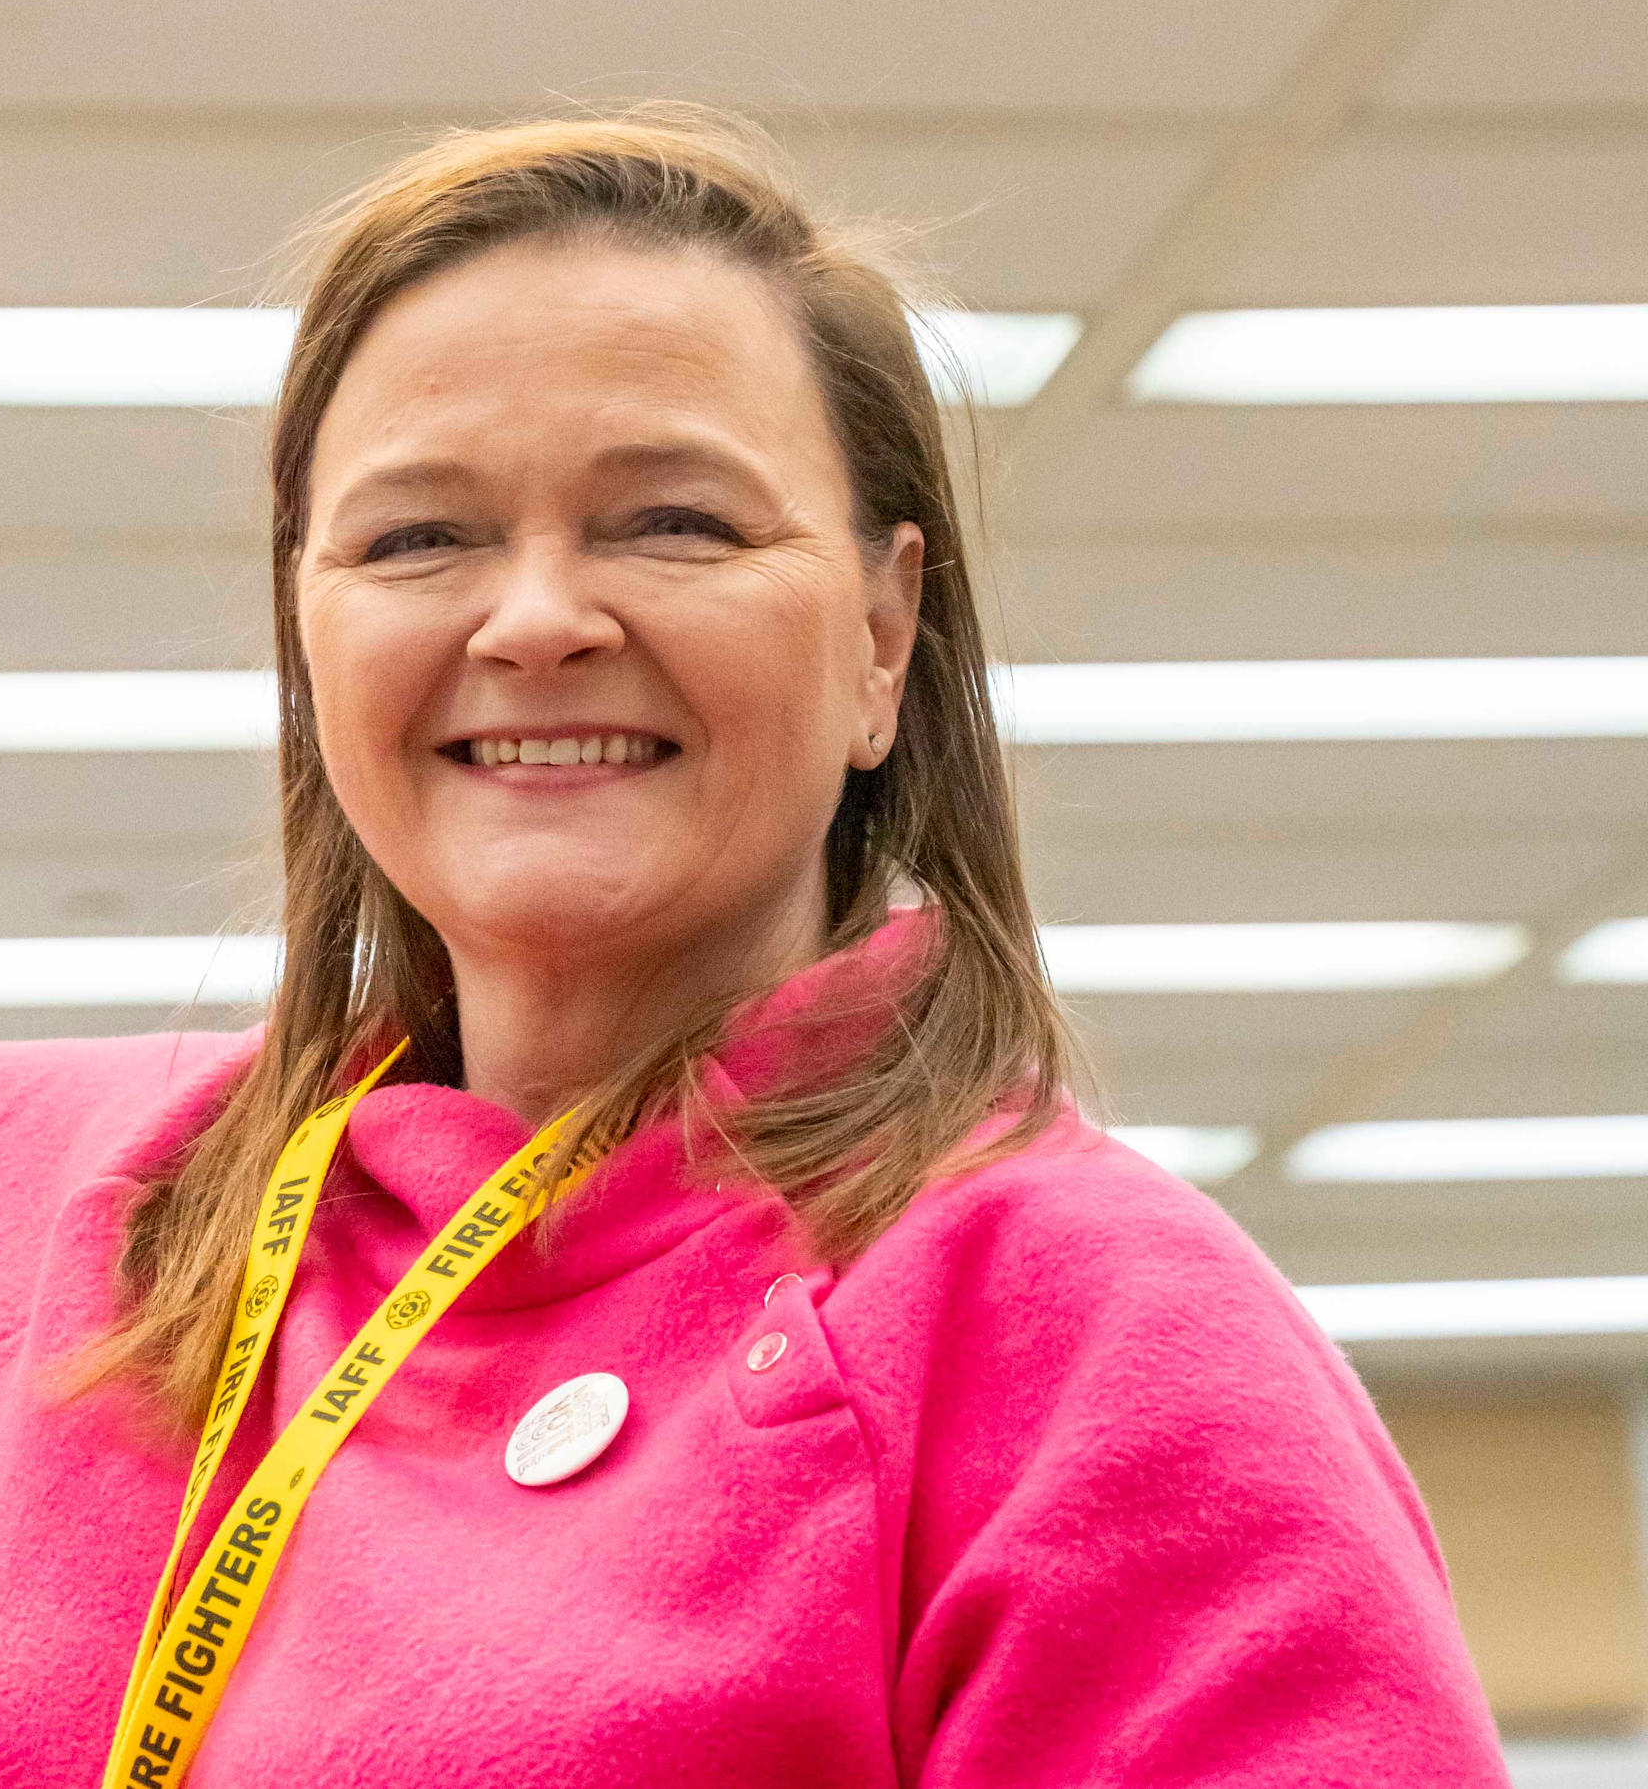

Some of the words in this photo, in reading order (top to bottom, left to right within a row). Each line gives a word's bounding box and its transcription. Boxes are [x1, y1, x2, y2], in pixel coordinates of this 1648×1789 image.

[262, 1175, 310, 1257] IAFF
[213, 1332, 259, 1423] FIRE
[154, 1497, 282, 1722] FIGHTERS
[310, 1341, 386, 1424] IAFF
[426, 1201, 513, 1278] FIRE
